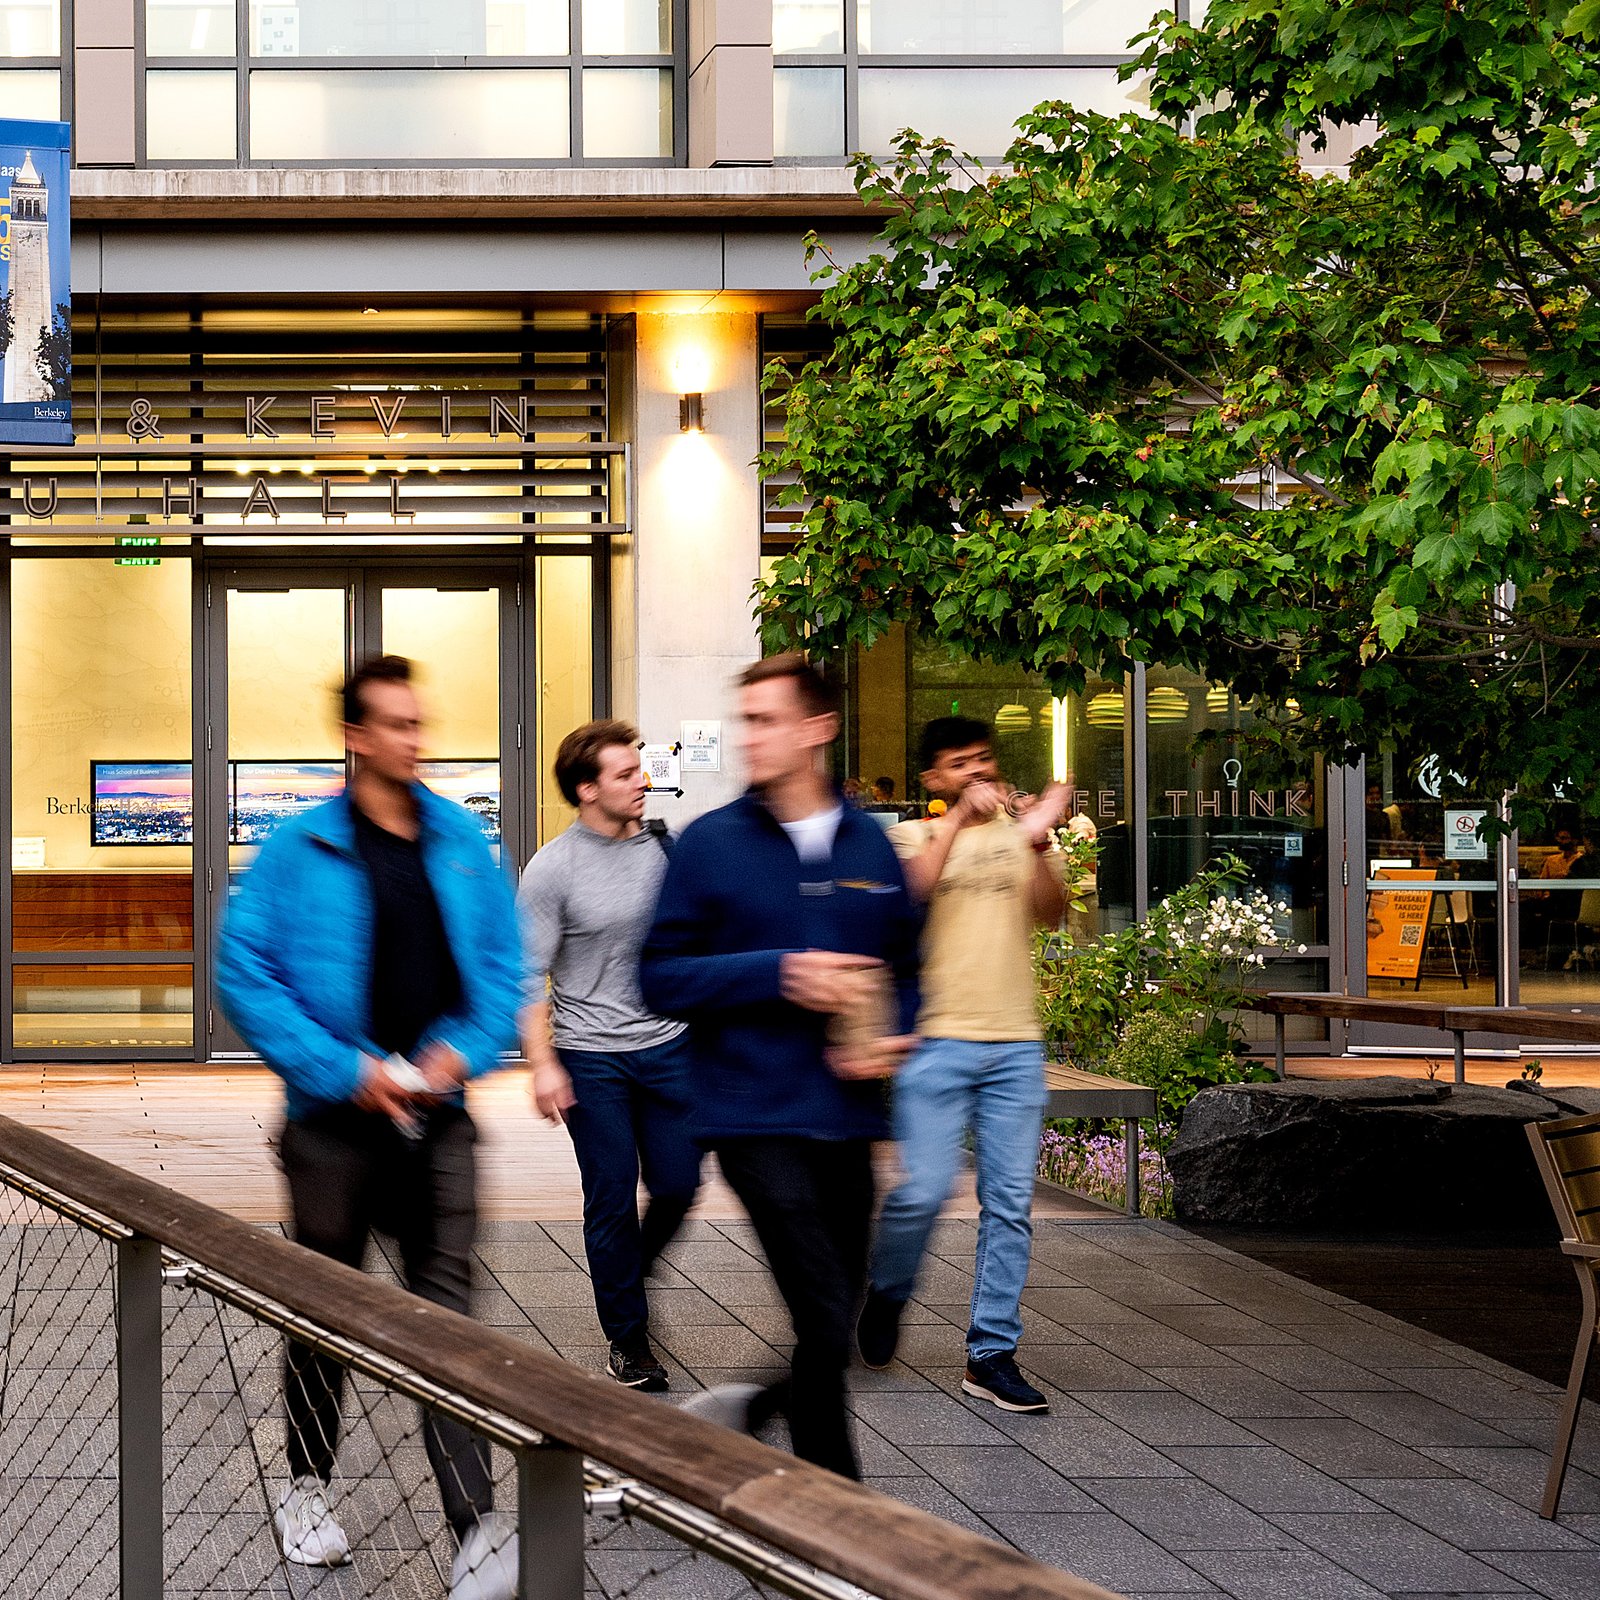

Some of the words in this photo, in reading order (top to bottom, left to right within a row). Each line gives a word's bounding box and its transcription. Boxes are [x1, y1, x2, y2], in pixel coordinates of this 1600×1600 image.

[34, 406, 67, 420] Berkeley
[126, 398, 164, 438] &
[245, 396, 528, 438] KEVIN
[162, 476, 416, 519] HALL
[1005, 790, 1115, 817] CFE
[1165, 790, 1307, 817] THINK
[1393, 895, 1427, 903] REUSABLE
[1394, 903, 1426, 911] TAKEOUT
[1406, 912, 1424, 920] HERE
